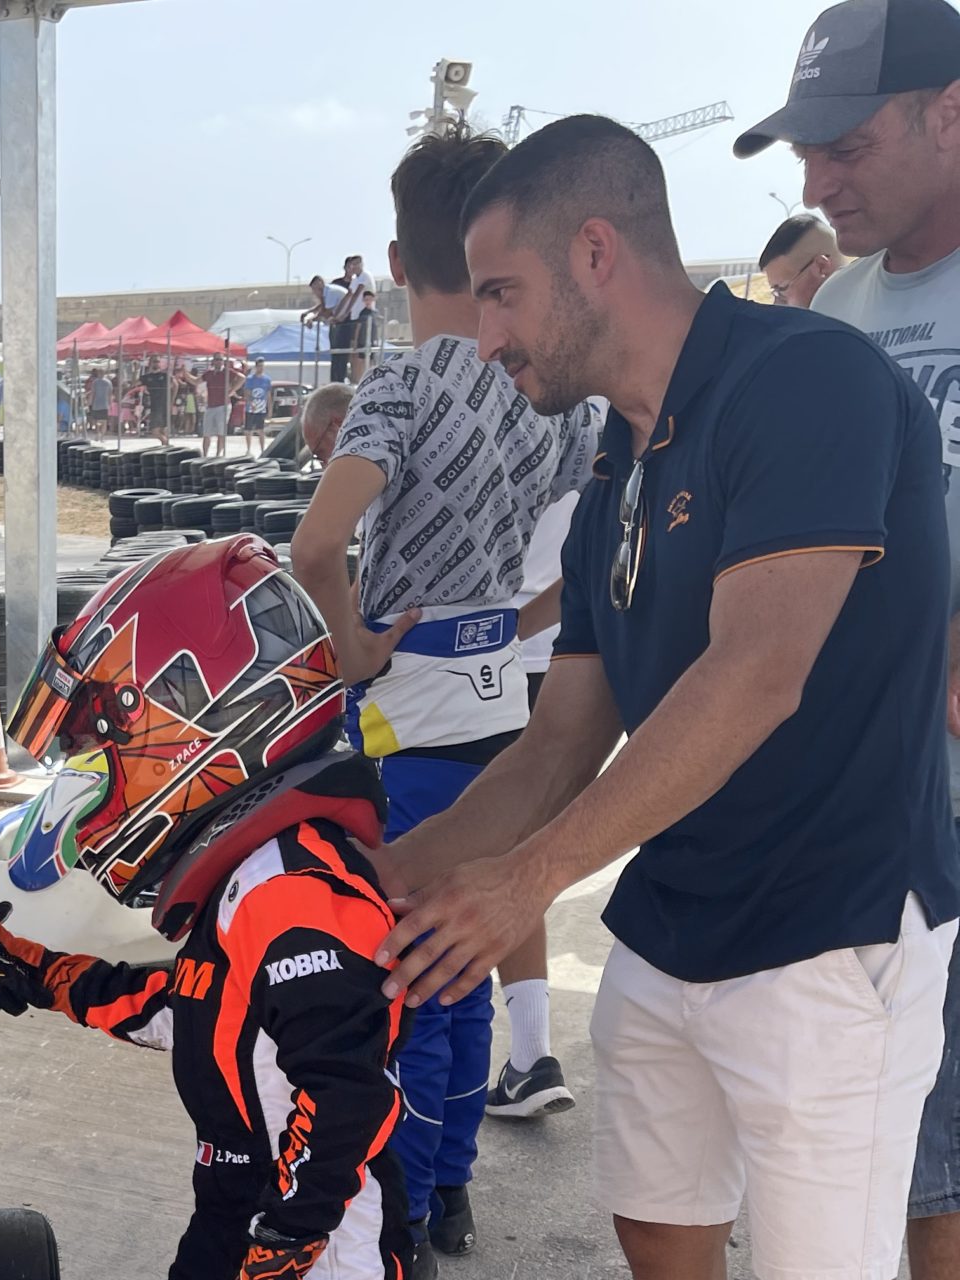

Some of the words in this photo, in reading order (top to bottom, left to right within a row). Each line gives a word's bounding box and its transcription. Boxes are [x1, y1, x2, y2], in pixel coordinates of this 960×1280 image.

[792, 66, 821, 84] idas
[868, 321, 936, 349] NATIONAL
[440, 430, 484, 488] caldwell
[404, 510, 451, 560] caldwell
[265, 949, 343, 986] KOBRA
